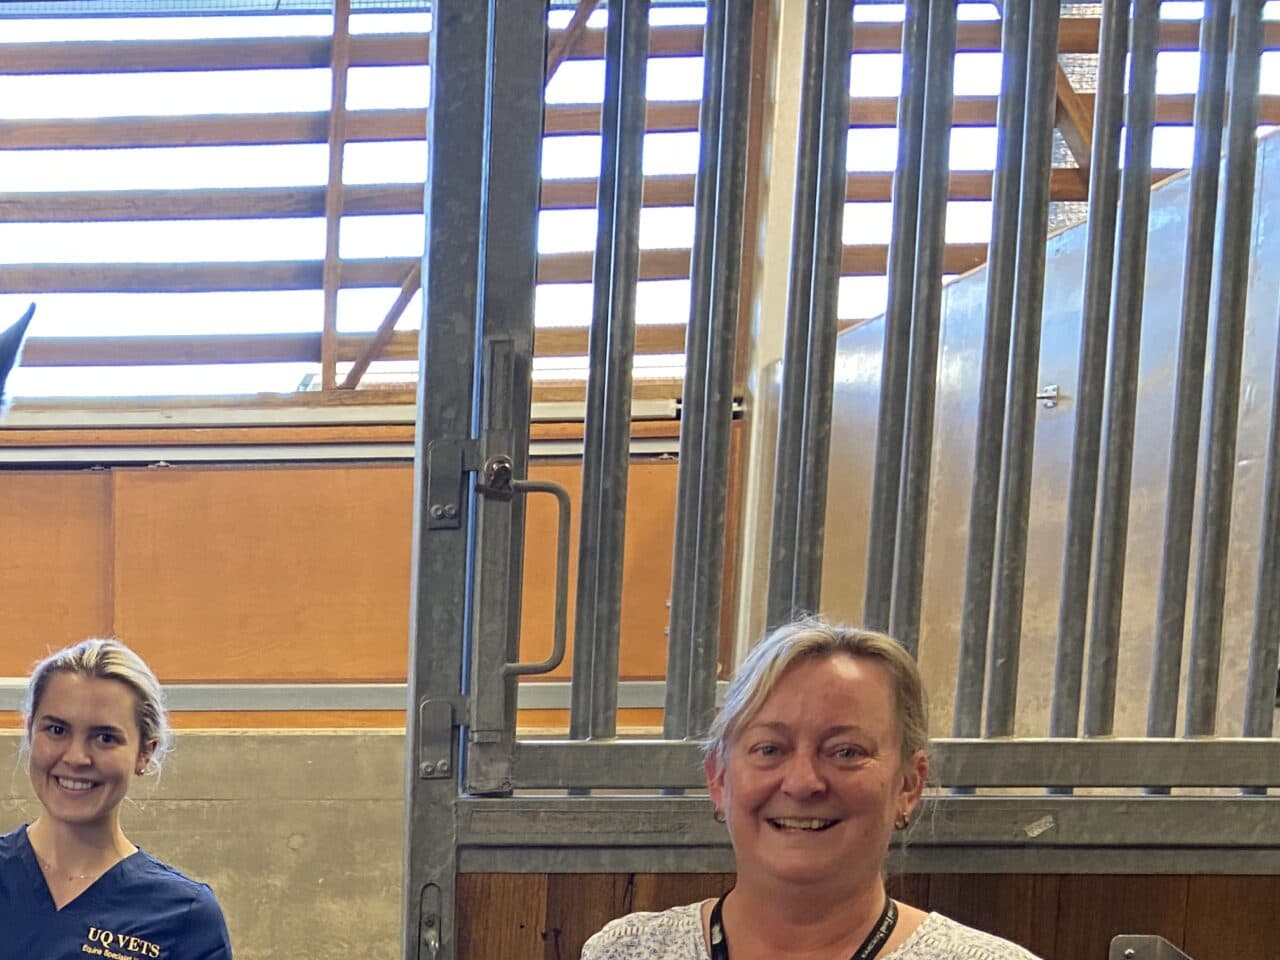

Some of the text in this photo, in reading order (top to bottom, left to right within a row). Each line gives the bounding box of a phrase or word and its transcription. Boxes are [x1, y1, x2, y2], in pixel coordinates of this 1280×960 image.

[82, 944, 102, 955] Equine
[88, 927, 160, 958] UQ VETS
